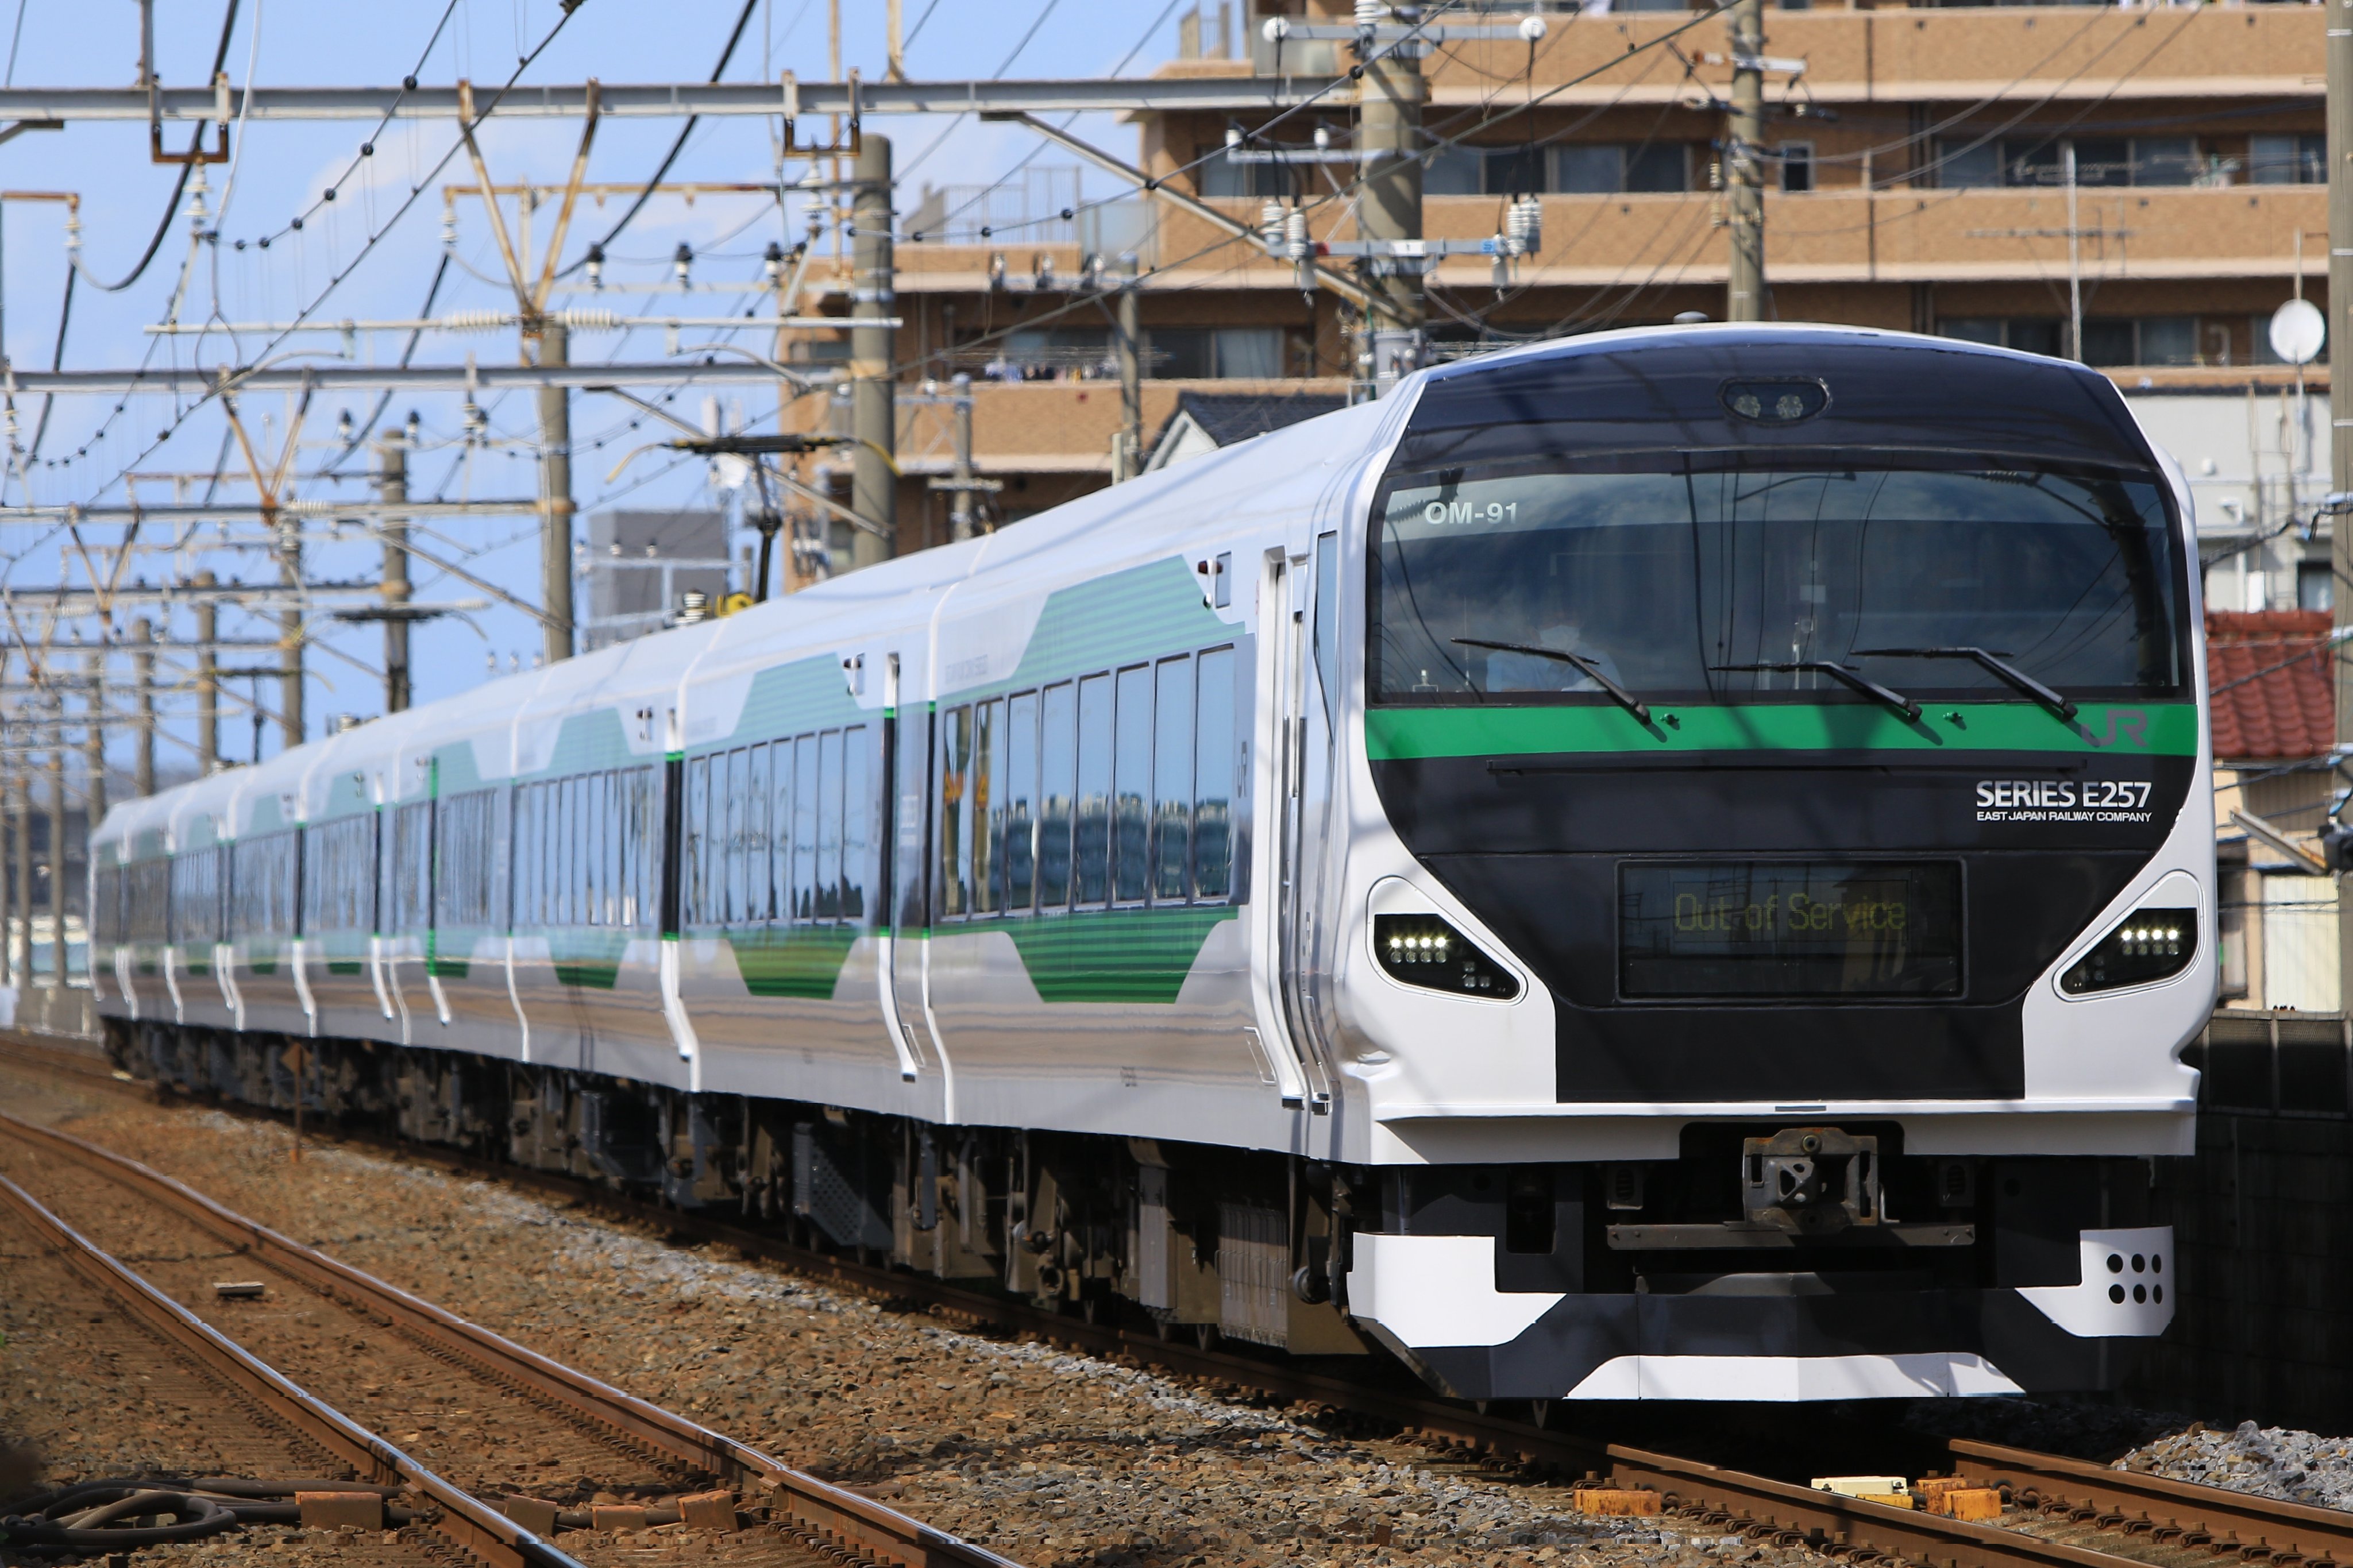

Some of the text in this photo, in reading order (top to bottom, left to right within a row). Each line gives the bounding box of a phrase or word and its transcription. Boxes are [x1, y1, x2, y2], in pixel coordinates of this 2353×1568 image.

[1425, 501, 1517, 524] OM-91
[2081, 709, 2148, 747] JR
[1976, 780, 2153, 809] SERIES E257
[1977, 811, 2153, 822] EAST JAPAN RAILWAY COMPANY
[1675, 893, 1906, 930] Out of Service
